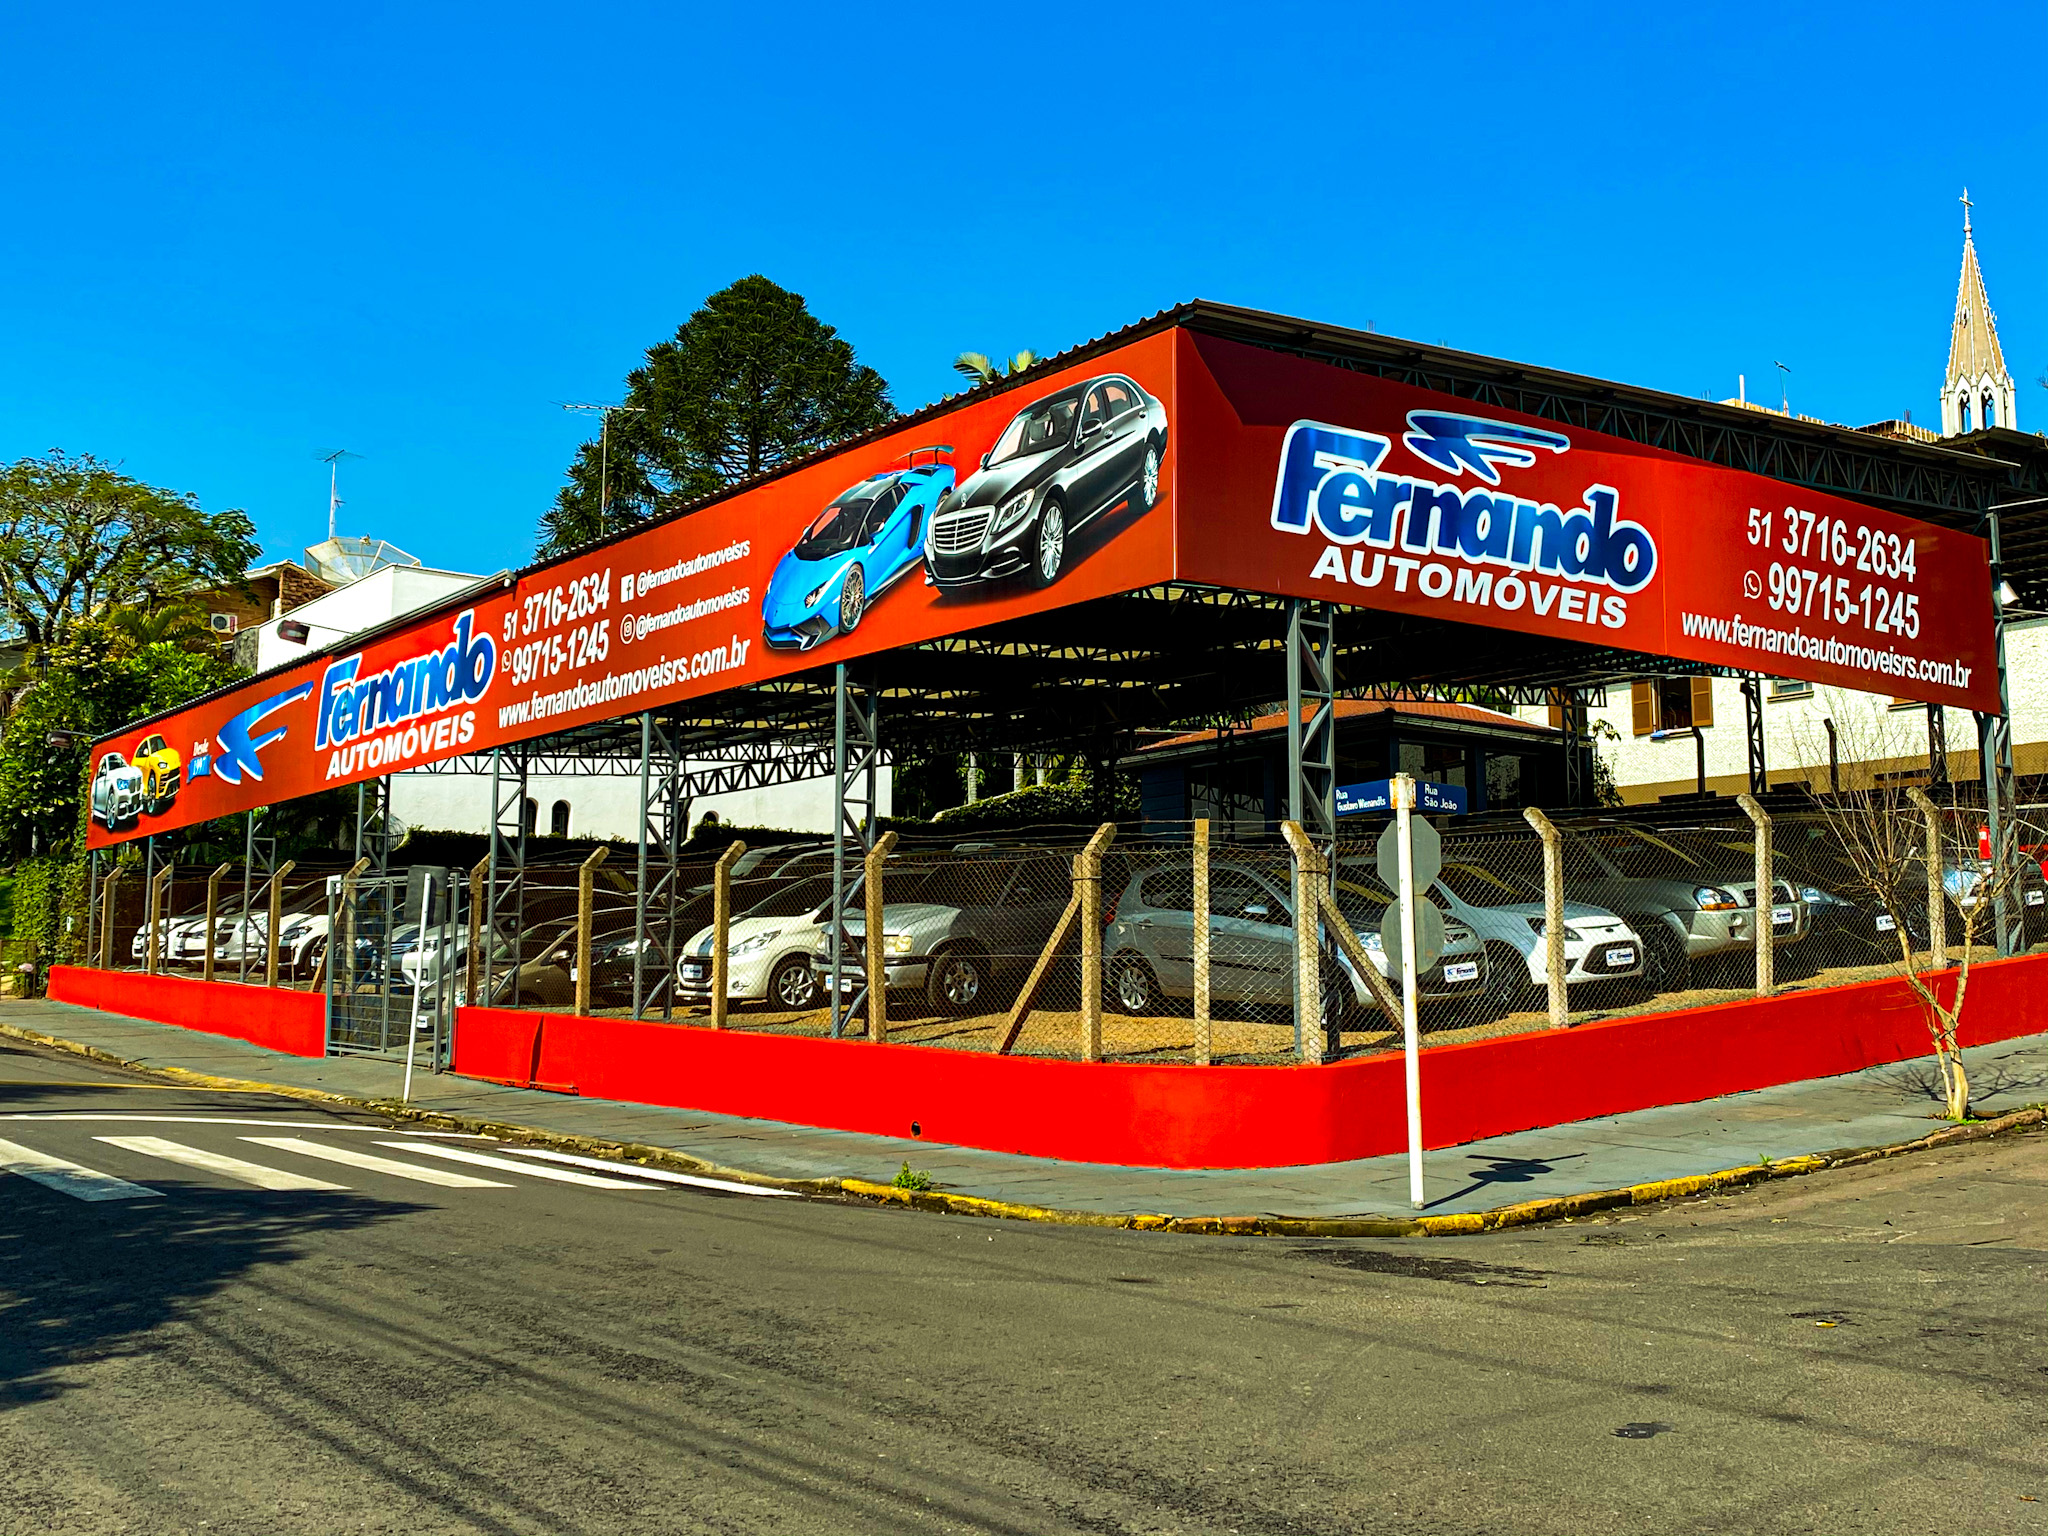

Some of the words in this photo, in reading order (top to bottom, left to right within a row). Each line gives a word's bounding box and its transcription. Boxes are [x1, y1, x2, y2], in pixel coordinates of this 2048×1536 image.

[1270, 419, 1657, 593] Fernando
[637, 540, 750, 597] @fernandoautomoveisrs
[1747, 507, 1772, 548] 51
[1781, 506, 1917, 583] 3716-2634
[503, 609, 518, 642] 51
[522, 568, 610, 636] 3716-2634
[636, 586, 750, 640] @fernandoautomoveisrs
[1310, 546, 1628, 629] AUTOMÓVEIS
[1768, 562, 1919, 639] 99715-1245
[315, 609, 496, 751] Fernando
[499, 634, 750, 728] www.fernandoautomoveisrs.com.br
[512, 619, 610, 686] 99715-1245
[1682, 612, 1971, 689] www.fernandoautomoveisrs.com.br
[325, 711, 475, 780] AUTOMÓVEIS
[1336, 789, 1348, 800] Rua
[1424, 796, 1439, 808] São
[1440, 798, 1457, 810] João
[1425, 784, 1438, 796] Rua
